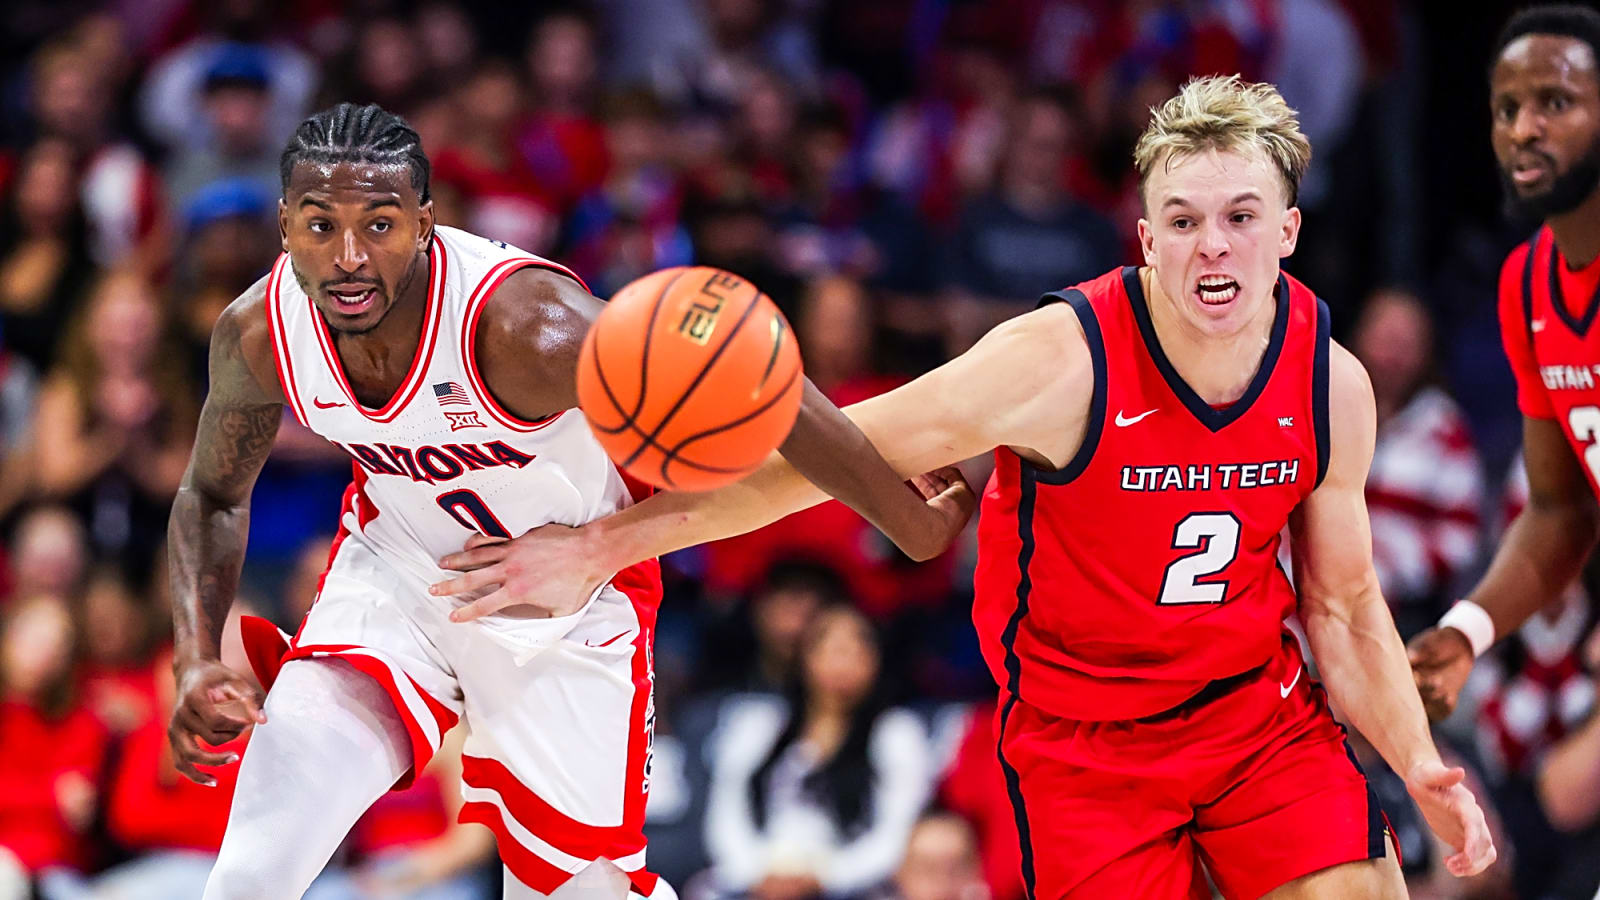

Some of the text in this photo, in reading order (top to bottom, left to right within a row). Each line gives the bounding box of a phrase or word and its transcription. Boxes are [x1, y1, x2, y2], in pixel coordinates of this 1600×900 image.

[678, 271, 741, 340] ELITE
[1277, 417, 1294, 427] WAC
[1120, 459, 1300, 491] UTAH TECH
[436, 488, 513, 539] 0
[1155, 511, 1242, 606] 2
